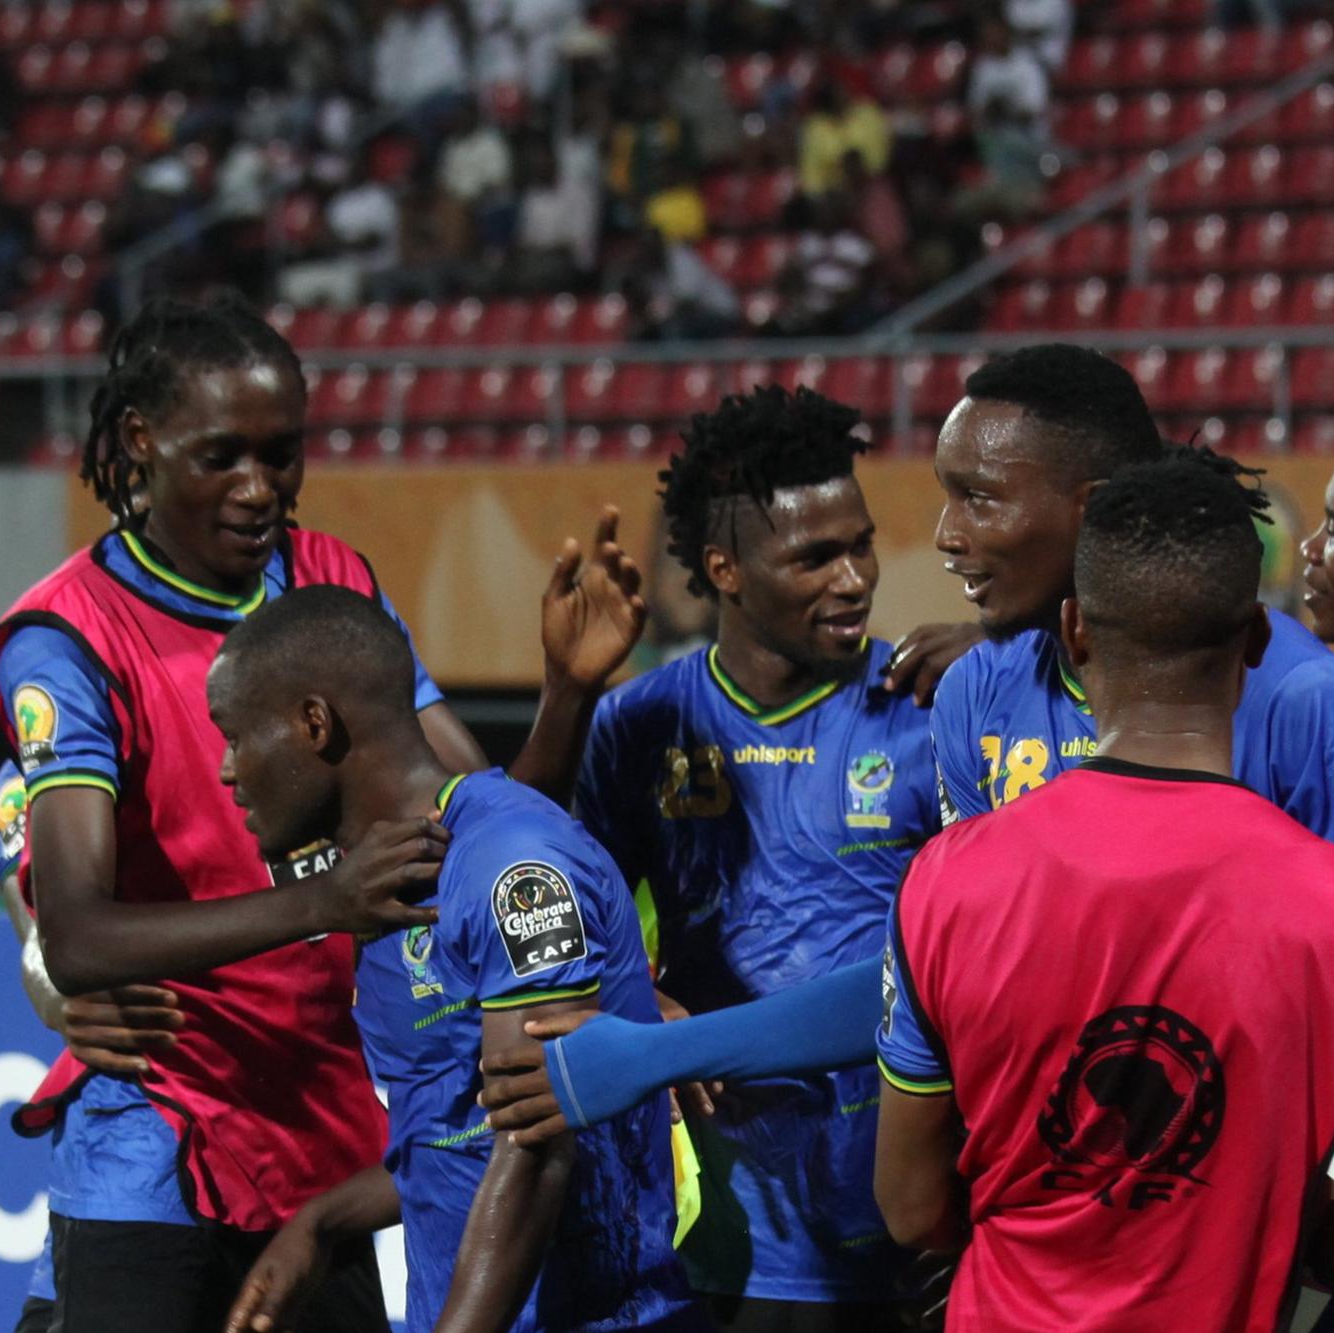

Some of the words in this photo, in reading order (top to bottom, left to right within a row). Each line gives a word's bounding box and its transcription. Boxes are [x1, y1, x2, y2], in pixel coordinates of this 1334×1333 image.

[734, 745, 815, 765] uhlsport
[293, 848, 336, 880] CAF
[504, 901, 572, 936] Celebrate
[520, 916, 562, 942] Africa
[527, 939, 573, 965] CAF
